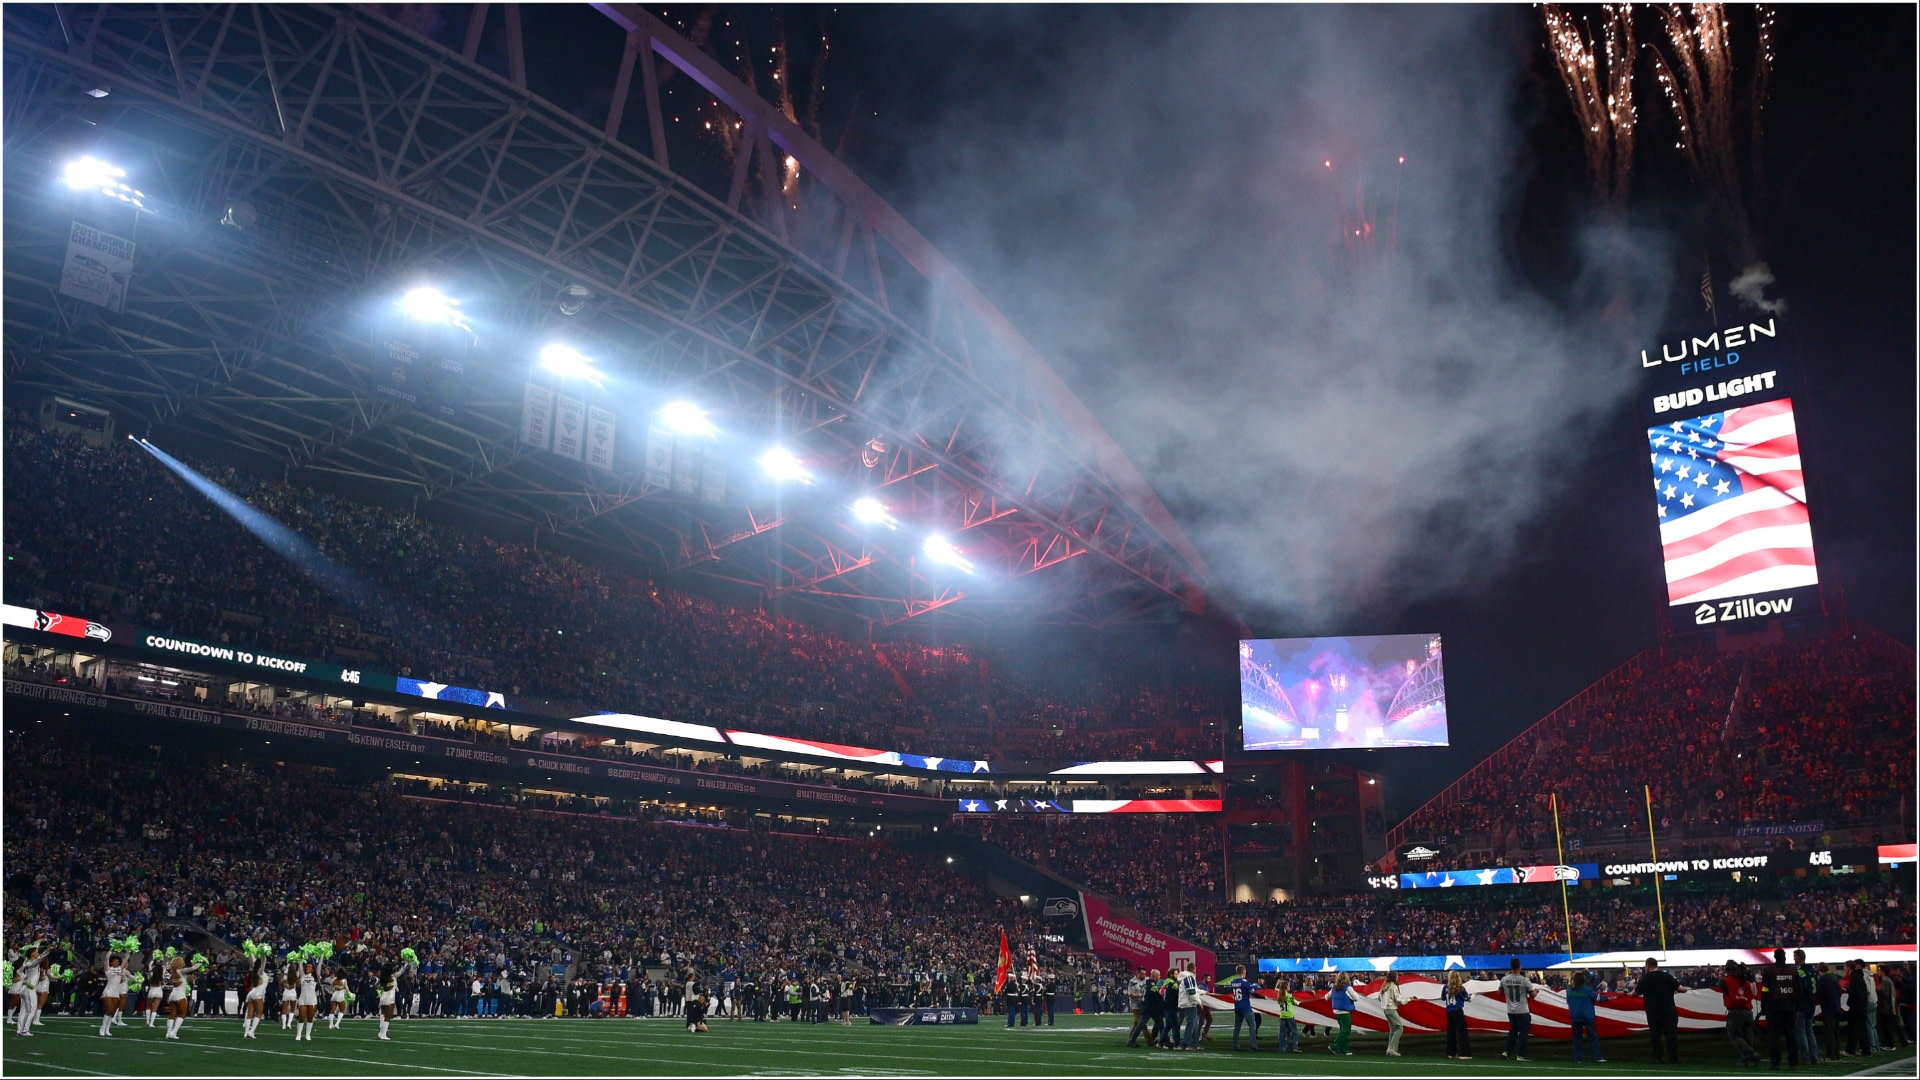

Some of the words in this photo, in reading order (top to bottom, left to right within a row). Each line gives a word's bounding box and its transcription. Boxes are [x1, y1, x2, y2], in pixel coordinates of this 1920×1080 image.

[71, 234, 132, 261] CHAMPIONS
[73, 224, 98, 241] 2013
[100, 233, 133, 253] WORLD
[1641, 318, 1776, 368] LUMEN
[1681, 352, 1740, 376] FIELD
[1653, 388, 1703, 414] BUD
[1705, 370, 1777, 402] LIGHT
[1718, 597, 1793, 622] Zillow
[146, 635, 233, 660] COUNTDOWN
[237, 651, 254, 664] TO
[256, 655, 307, 673] KICKOFF
[340, 669, 361, 684] 4:45
[5, 682, 22, 695] 28
[23, 684, 48, 699] CURT
[48, 688, 87, 705] WARNER
[147, 703, 168, 717] PAUL
[169, 707, 178, 718] G.
[179, 709, 204, 722] ALLEN
[245, 718, 259, 730] 79
[258, 720, 283, 733] JACOB
[283, 724, 309, 737] GREEN
[347, 732, 361, 745] 45
[360, 735, 385, 748] KENNY
[385, 738, 410, 751] EASLEY
[444, 746, 456, 757] 17
[455, 749, 473, 760] DAVE
[473, 750, 494, 762] KRIEG
[537, 759, 559, 771] CHUCK
[559, 761, 577, 773] KNOX
[607, 767, 619, 778] 96
[618, 769, 641, 781] CORTEZ
[641, 772, 667, 784] KENNEDY
[704, 779, 727, 790] WALTER
[727, 782, 744, 792] JONES
[802, 790, 816, 801] MATT
[1764, 825, 1786, 835] THE
[1787, 823, 1824, 834] NOISE!
[1437, 836, 1447, 845] 12
[1569, 840, 1580, 850] 12
[1605, 860, 1689, 875] COUNTDOWN
[1691, 860, 1710, 871] TO
[1713, 856, 1768, 869] KICKOFF
[1809, 851, 1832, 865] 4:45
[1368, 875, 1398, 889] 4:45
[1037, 934, 1065, 942] MEN
[1095, 916, 1143, 941] America's
[1143, 933, 1167, 949] Best
[1103, 930, 1126, 944] Mobile
[1126, 938, 1155, 955] Network
